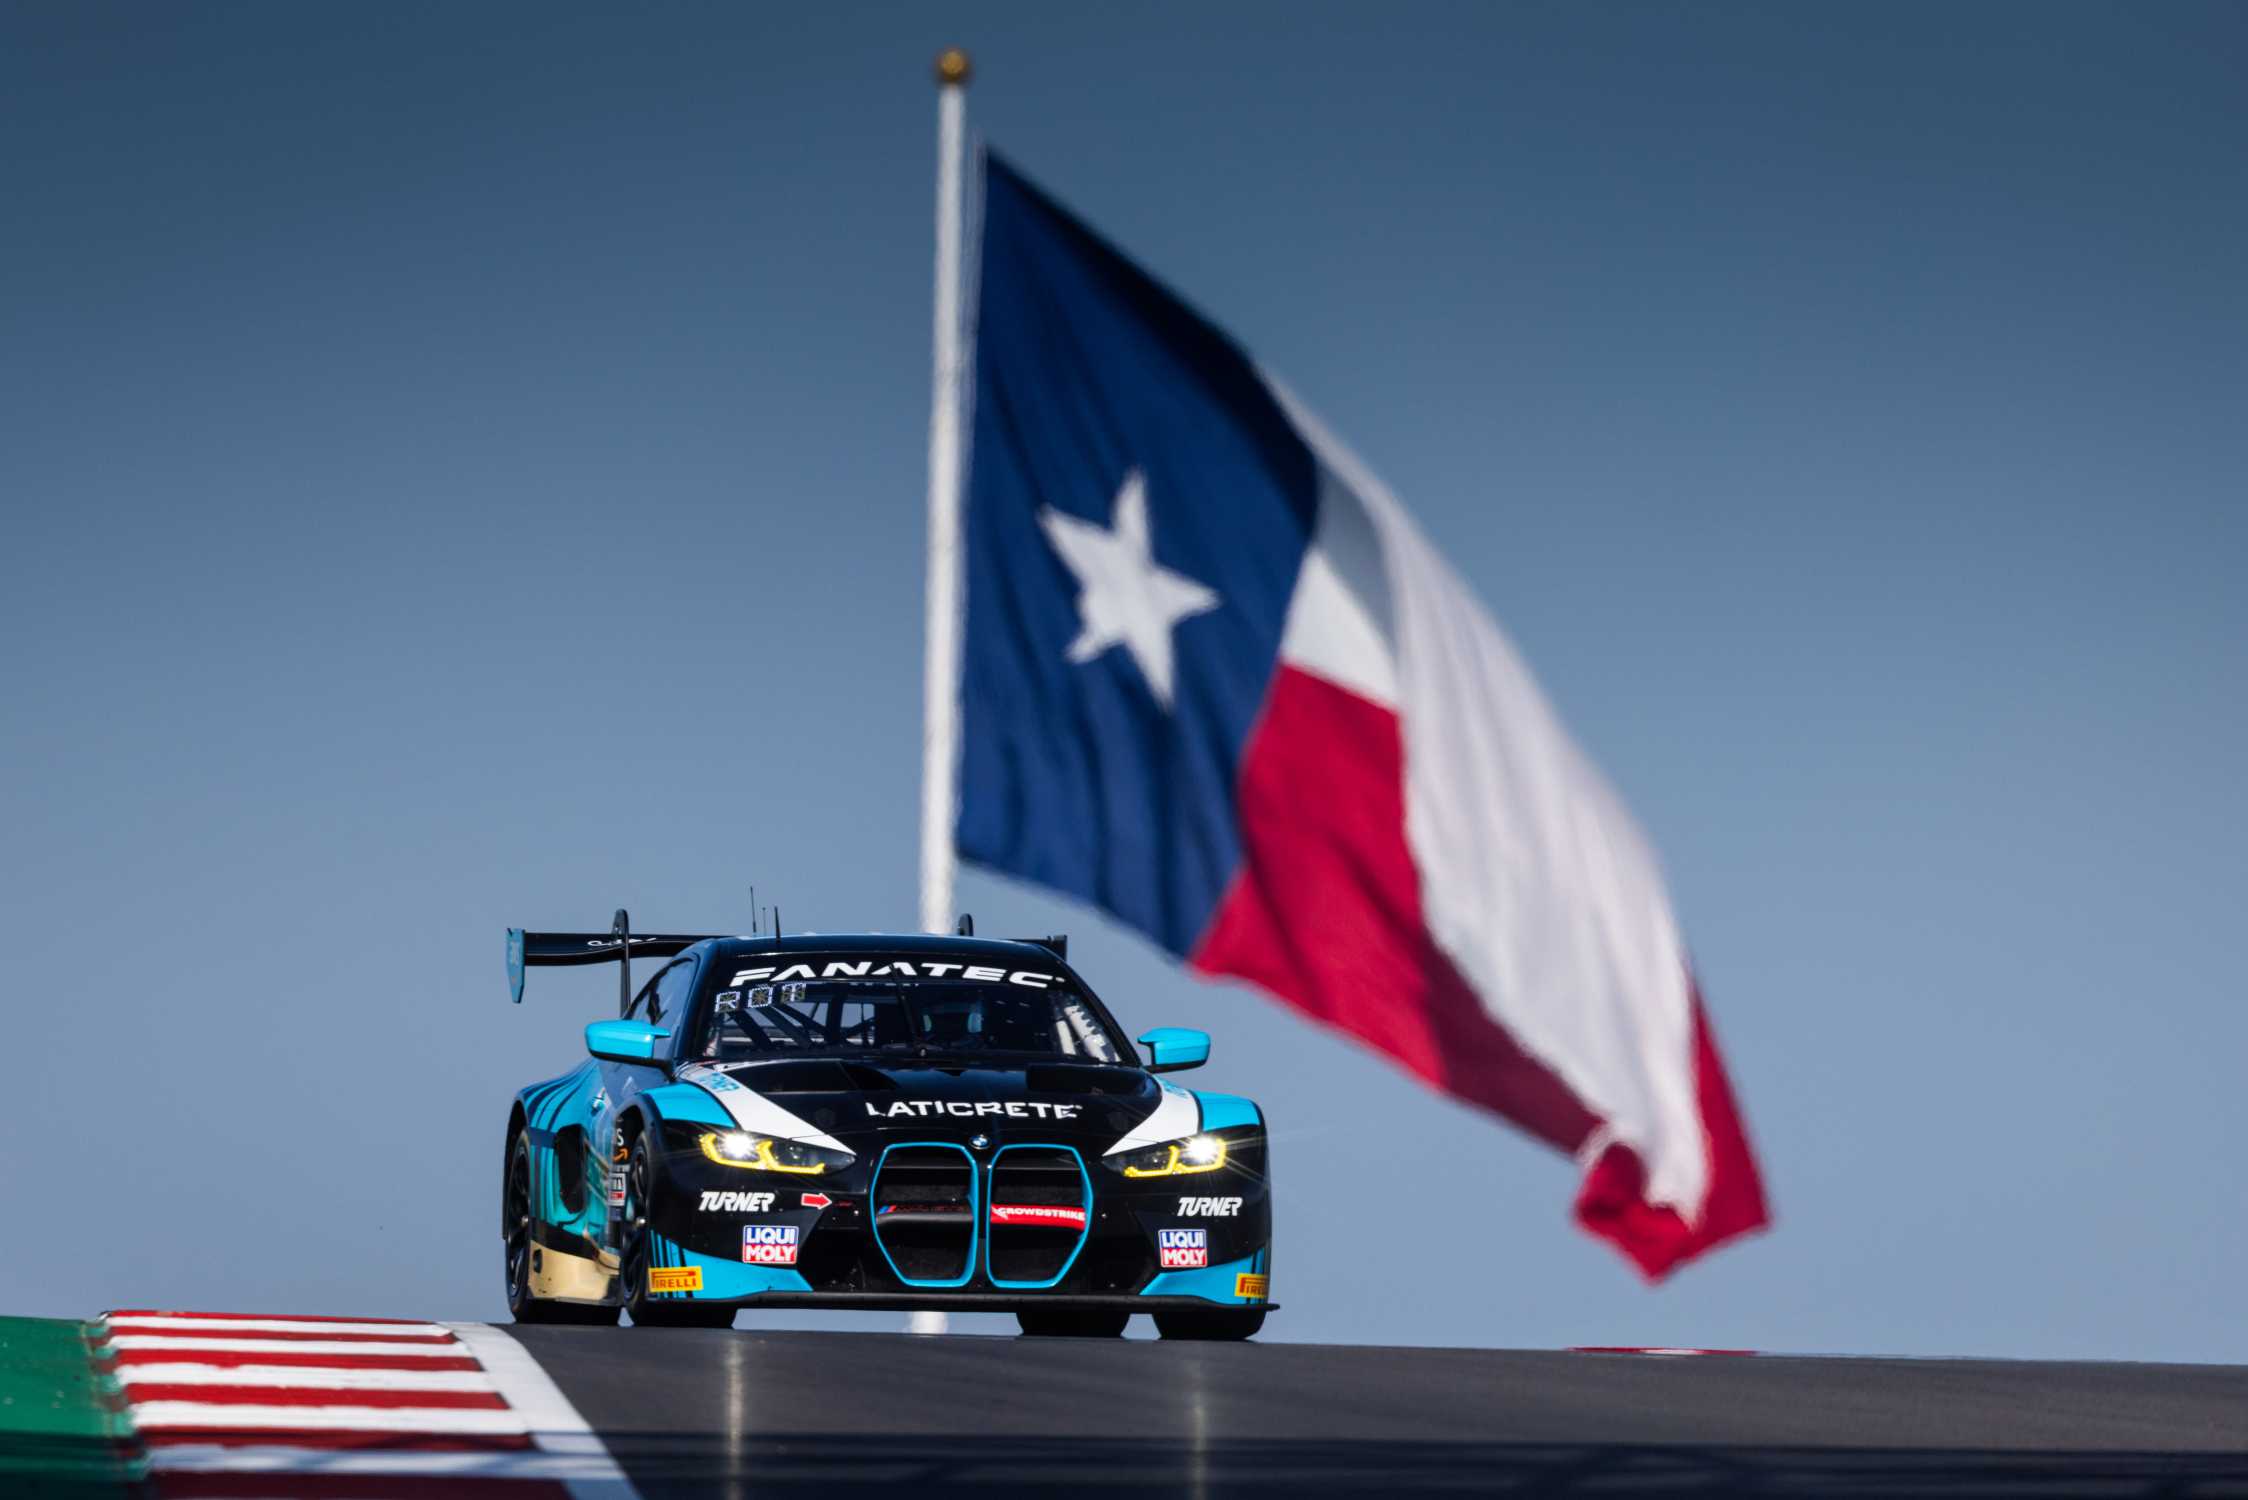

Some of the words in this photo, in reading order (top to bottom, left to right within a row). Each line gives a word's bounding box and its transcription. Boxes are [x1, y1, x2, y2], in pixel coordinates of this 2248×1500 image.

[729, 961, 1053, 988] FANATEC
[865, 1100, 1077, 1119] LATICRETE
[699, 1191, 775, 1212] TURNER
[1177, 1197, 1243, 1217] TURNER
[1000, 1207, 1085, 1221] CROWDSTRIKE
[746, 1227, 796, 1244] LIQUI
[1161, 1231, 1204, 1249] LIQUI
[746, 1245, 796, 1262] MOLY
[1162, 1249, 1205, 1265] MOLY
[651, 1270, 697, 1289] PIRELLI
